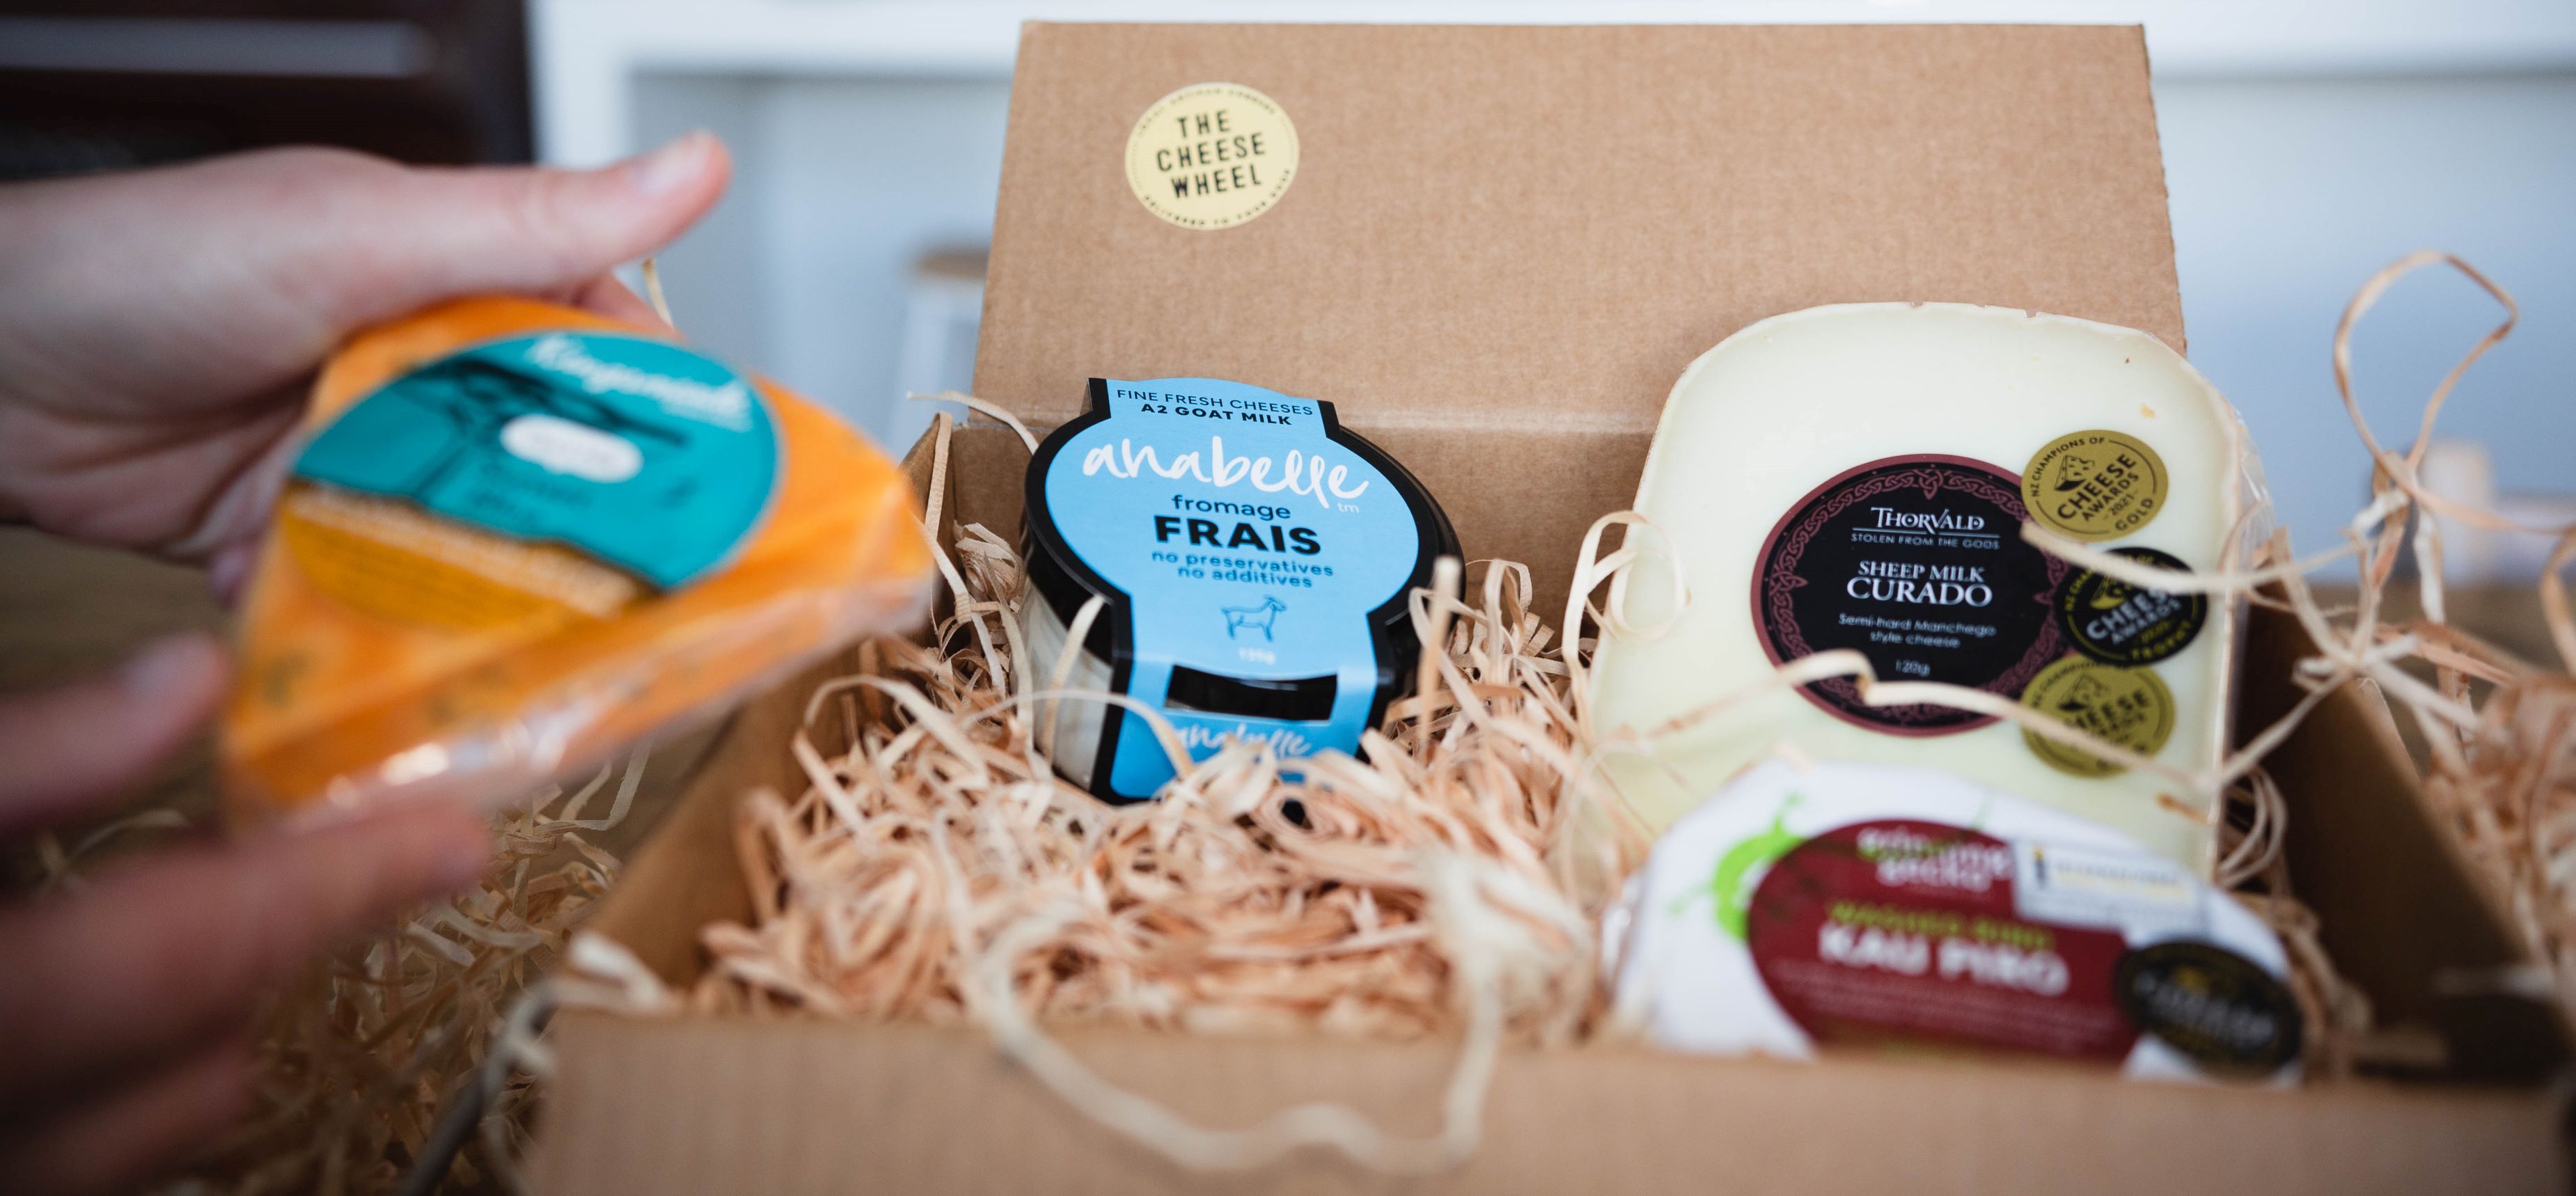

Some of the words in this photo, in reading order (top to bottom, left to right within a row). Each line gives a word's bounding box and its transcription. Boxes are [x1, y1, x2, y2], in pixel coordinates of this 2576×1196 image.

[1177, 110, 1230, 139] THE
[1156, 132, 1266, 172] CHEESE
[1171, 164, 1262, 198] WHEEL
[1116, 389, 1159, 402] FINE
[1164, 393, 1224, 407] FRESH
[1230, 399, 1314, 416] CHEESES
[1140, 403, 1169, 415] A2
[1175, 406, 1234, 420] GOAT
[1241, 412, 1293, 426] MILK
[2089, 436, 2105, 446] OF
[1081, 435, 1370, 509] anabelle
[2032, 439, 2086, 482] CHAMPIONS
[2030, 482, 2040, 498] NZ
[2057, 454, 2137, 519] CHEESE
[2081, 471, 2140, 521] AWARDS
[1170, 494, 1292, 521] fromage
[1337, 502, 1360, 514] tm
[2114, 497, 2154, 531] GOLD
[1153, 514, 1322, 556] FRAIS
[1851, 533, 1895, 544] STOLEN
[1898, 535, 1934, 546] FROM
[1938, 537, 1959, 548] THE
[1962, 539, 2000, 550] GODS
[1151, 551, 1179, 565] no
[1185, 555, 1334, 577] preservatives
[1177, 565, 1205, 579] no
[1212, 567, 1313, 589] additives
[1858, 560, 1926, 581] SHEEP
[1929, 565, 1986, 583] MILK
[1846, 576, 1993, 608] CURADO
[1838, 612, 1912, 630] Semi-hard
[1914, 620, 1997, 639] Manchego
[2086, 588, 2171, 640] CHEES
[1869, 630, 1903, 645] style
[1906, 634, 1961, 649] cheese
[1816, 920, 1930, 976] KAU
